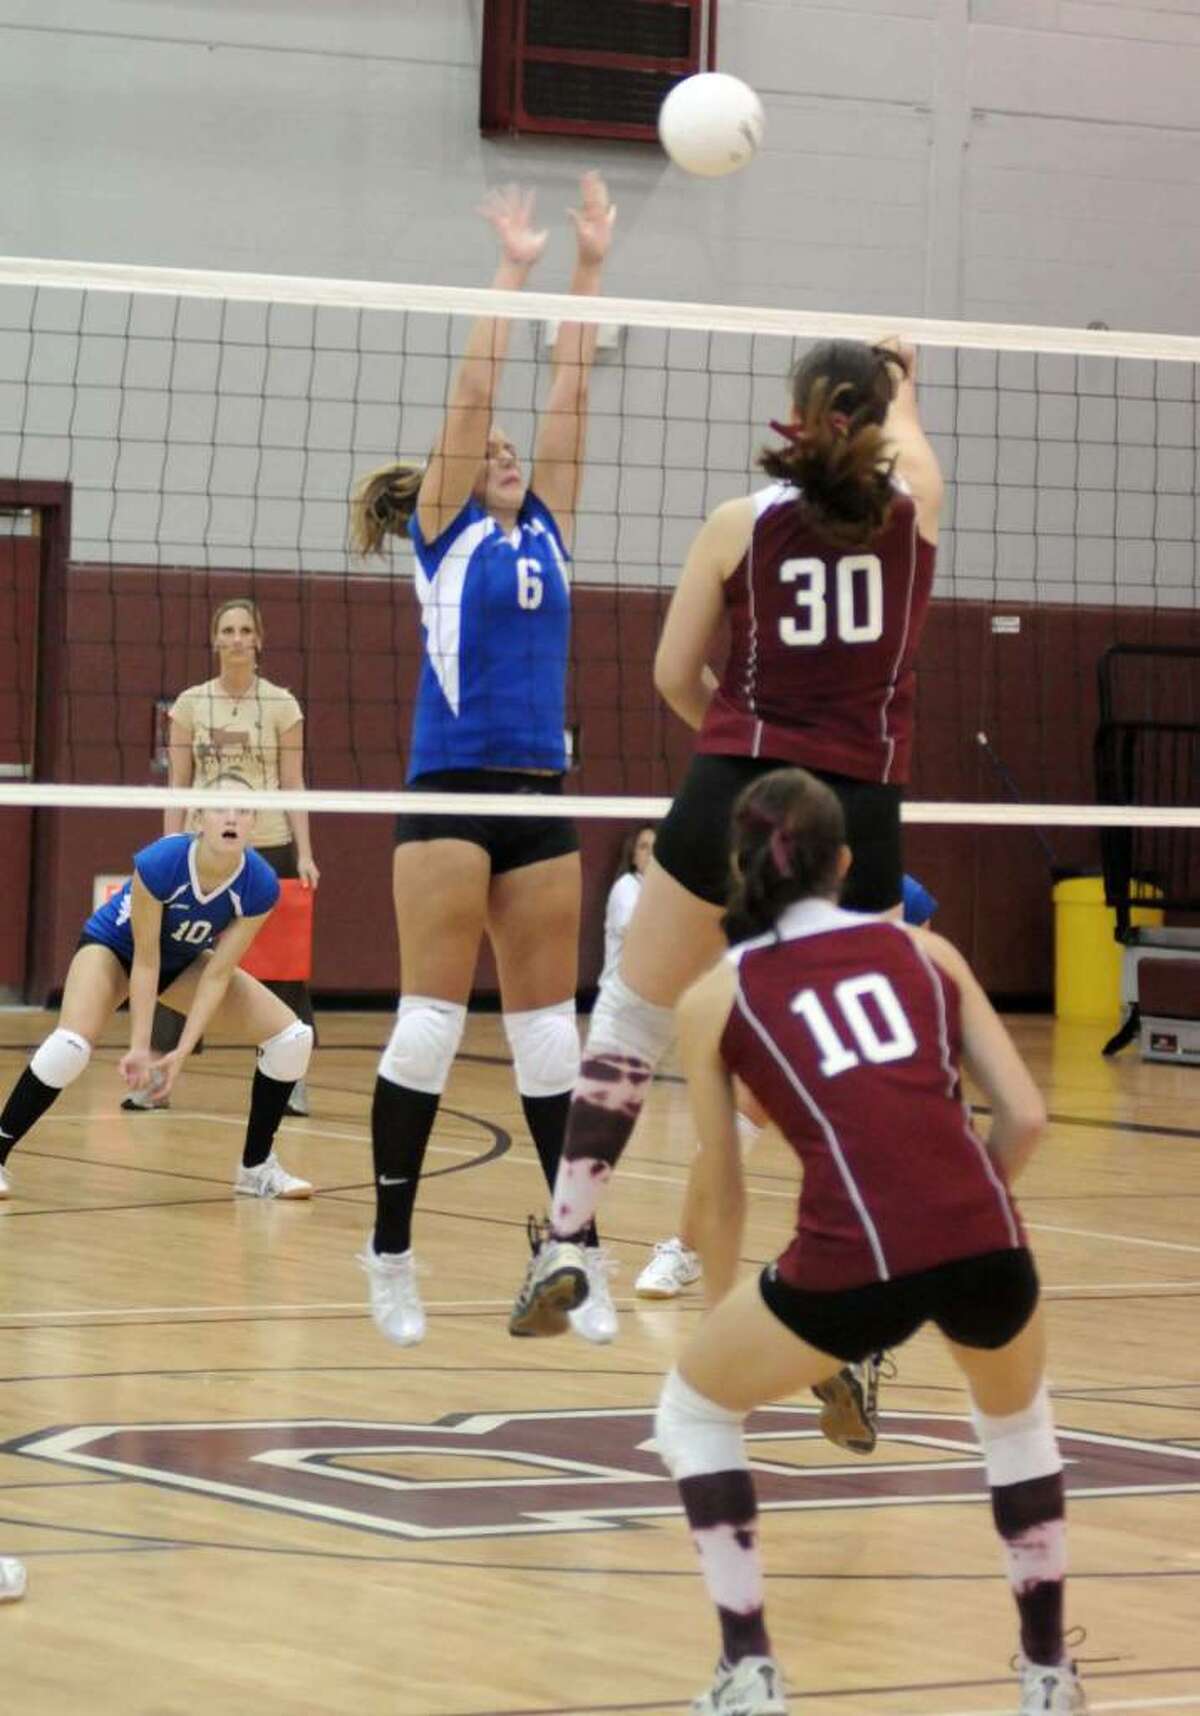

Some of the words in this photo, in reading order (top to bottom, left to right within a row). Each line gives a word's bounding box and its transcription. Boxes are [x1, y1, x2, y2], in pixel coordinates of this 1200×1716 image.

[517, 558, 543, 609] 6
[779, 554, 883, 646] 30
[171, 920, 212, 944] 10
[790, 973, 917, 1076] 10
